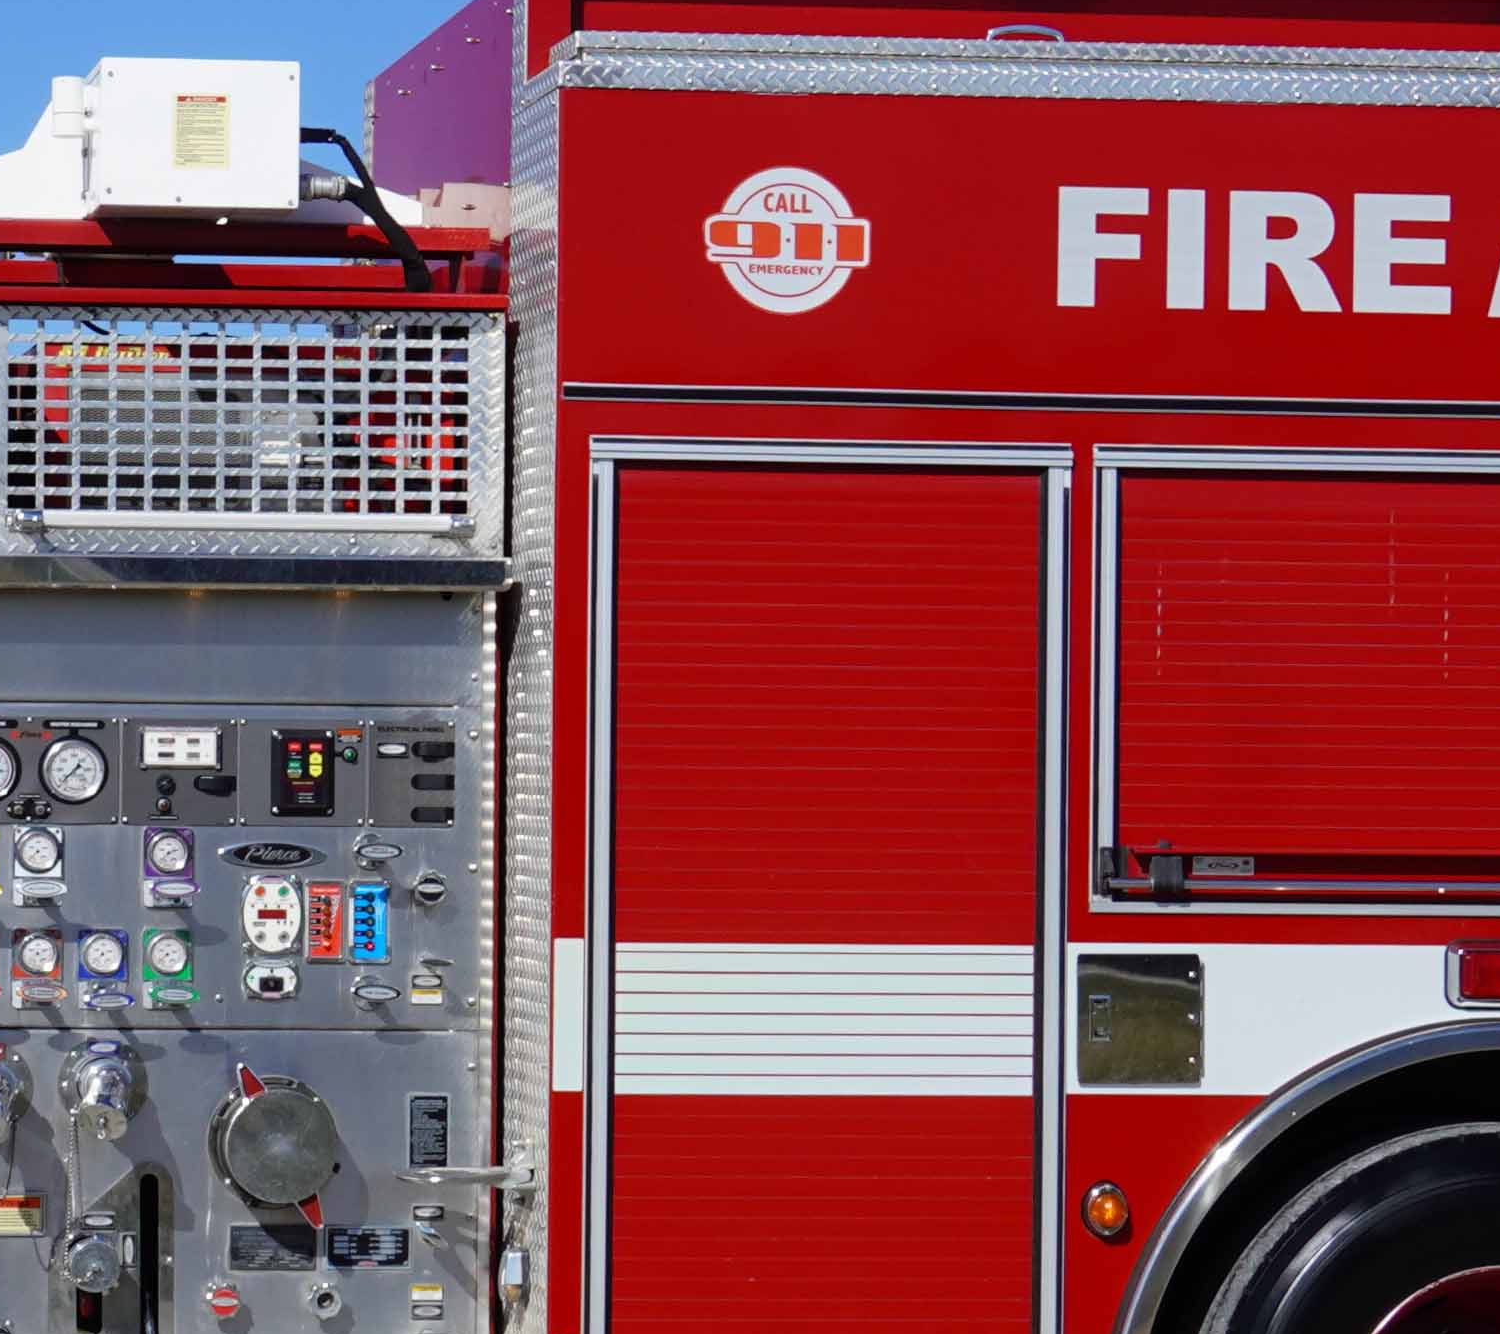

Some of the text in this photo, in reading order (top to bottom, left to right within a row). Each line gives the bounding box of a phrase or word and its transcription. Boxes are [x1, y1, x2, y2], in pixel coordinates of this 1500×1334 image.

[763, 192, 813, 214] CALL
[749, 263, 824, 276] EMERGENCY
[244, 844, 301, 862] Pierce
